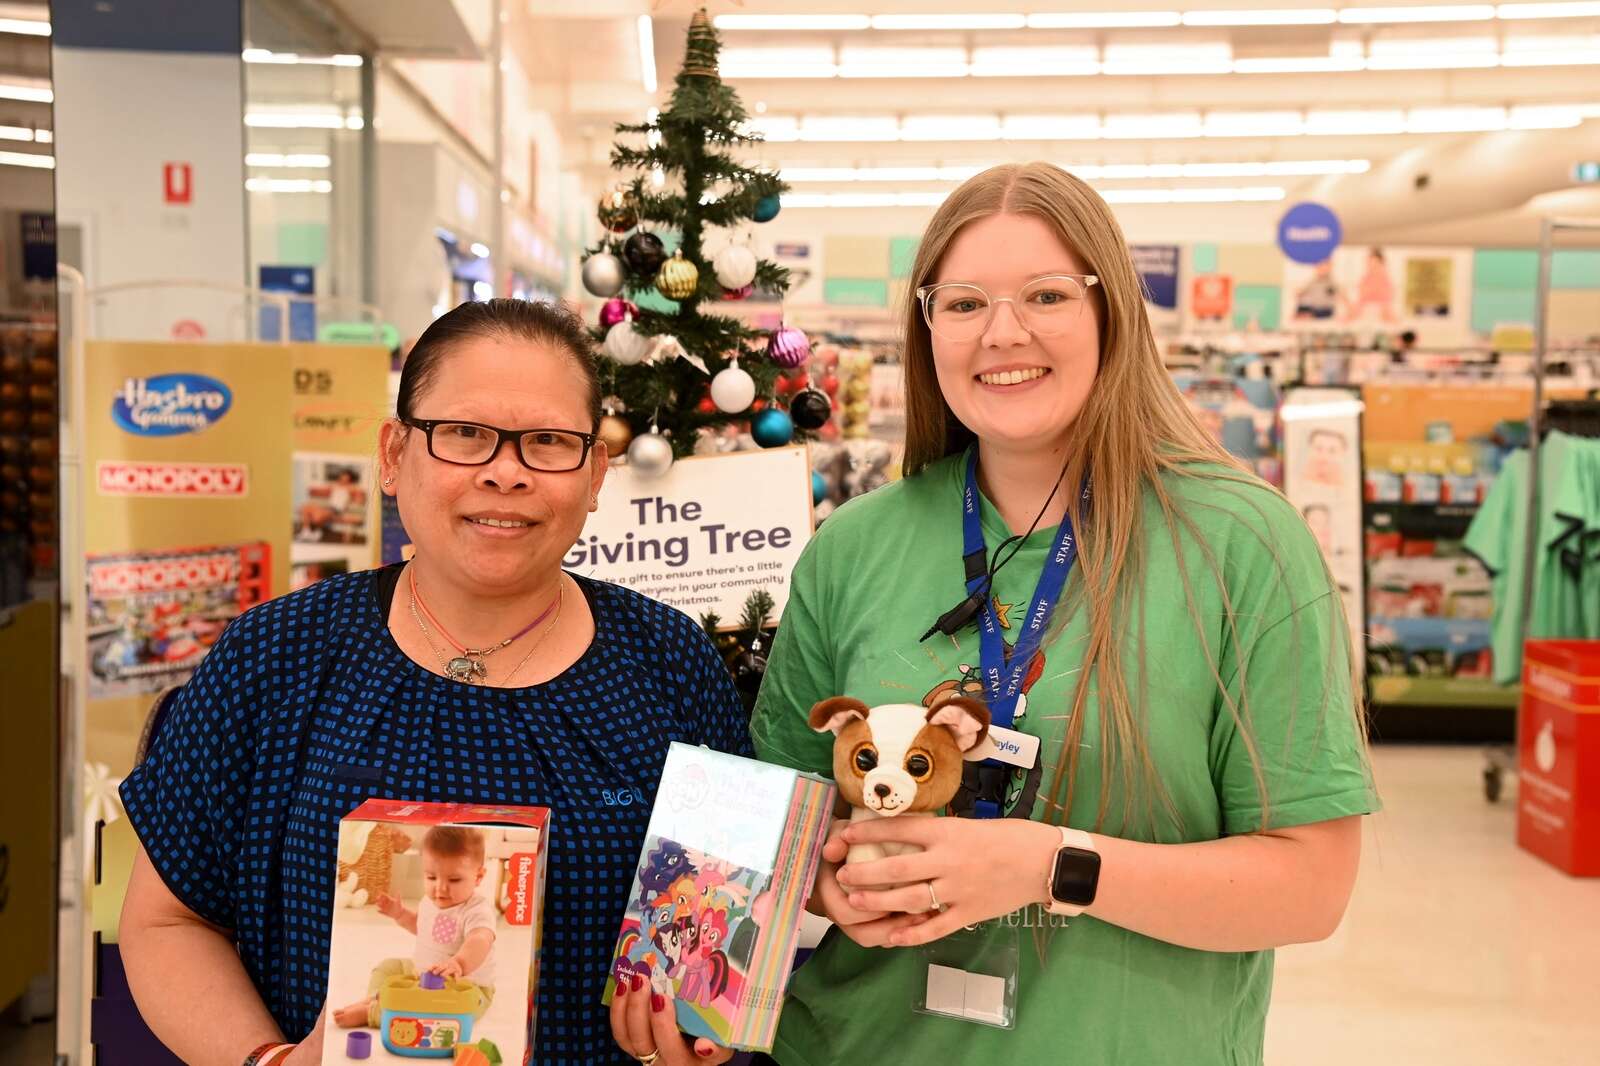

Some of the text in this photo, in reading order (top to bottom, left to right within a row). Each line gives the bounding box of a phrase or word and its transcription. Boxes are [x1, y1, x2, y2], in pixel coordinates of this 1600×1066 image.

[115, 377, 225, 411] Hasbro
[101, 465, 244, 493] MONOPOLY
[630, 497, 702, 525] The
[964, 487, 974, 514] STAFF
[561, 524, 792, 568] Giving Tree
[1055, 533, 1073, 564] STAFF
[93, 556, 234, 592] MONOPOLY
[629, 573, 649, 585] gift
[651, 573, 663, 581] to
[665, 569, 704, 580] ensure
[705, 564, 744, 576] there's
[757, 561, 783, 571] little
[679, 584, 690, 592] in
[692, 581, 718, 593] your
[720, 575, 785, 588] community
[984, 607, 995, 633] TAFF
[1031, 599, 1048, 630] STAFF
